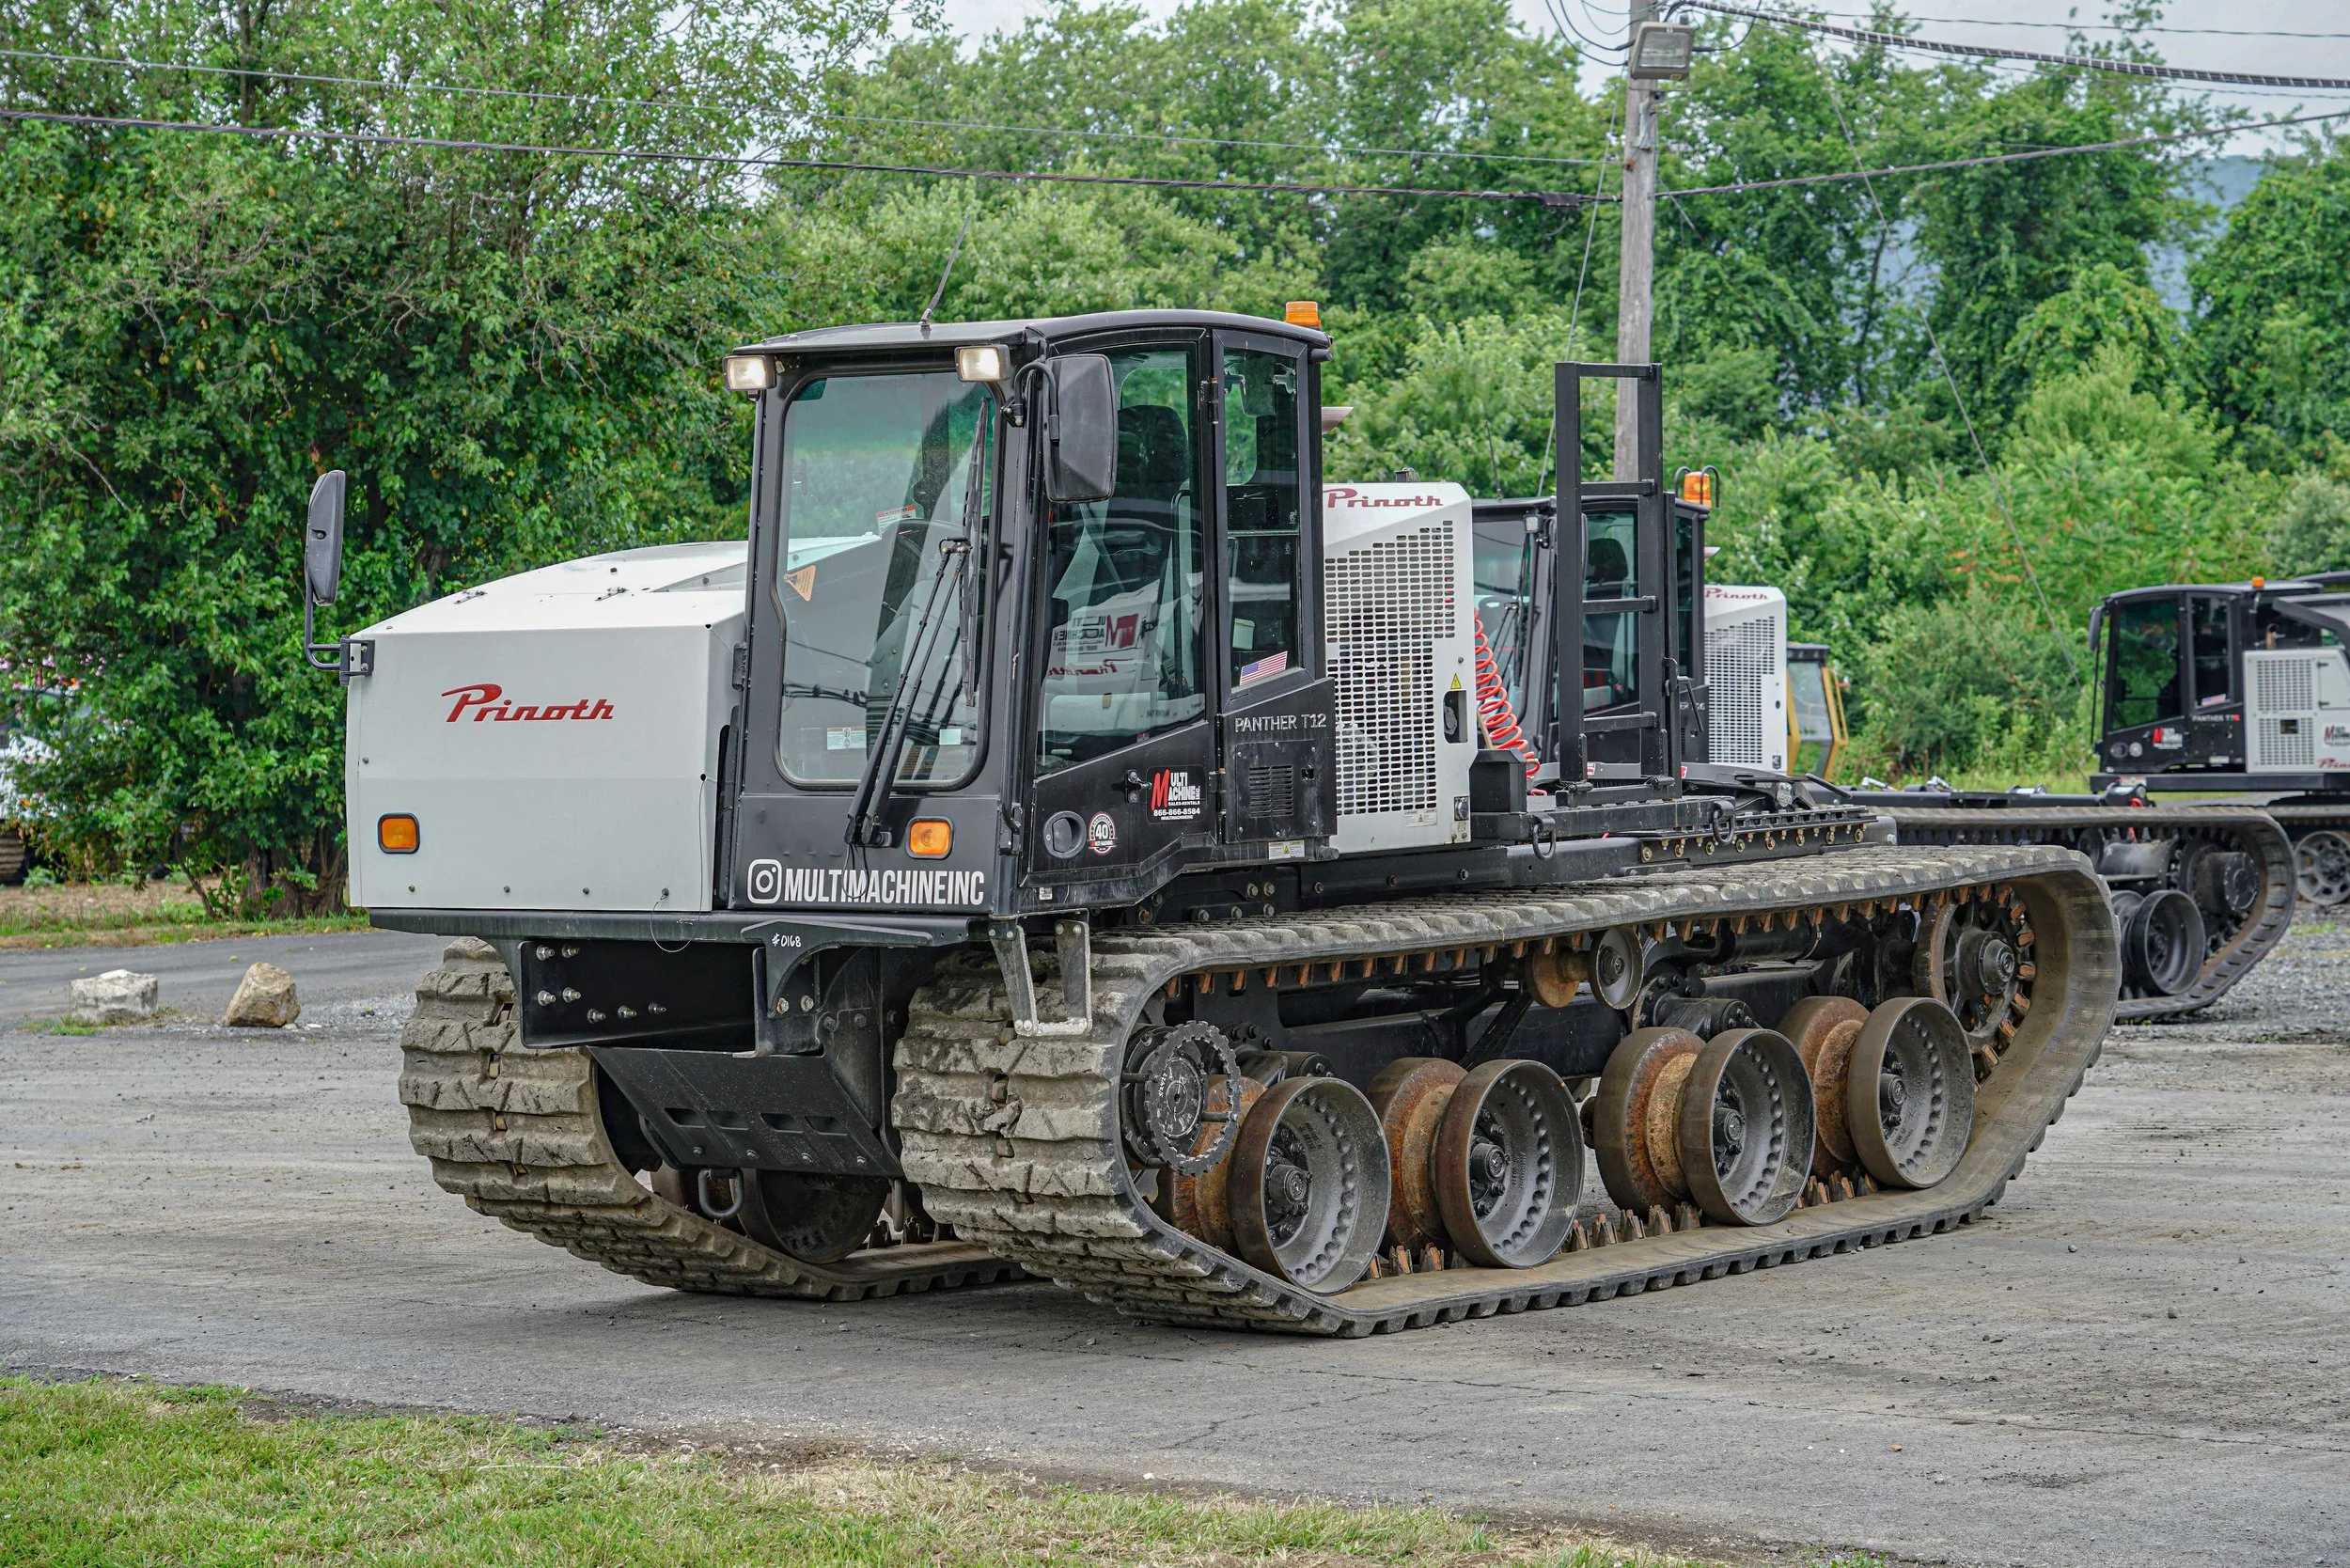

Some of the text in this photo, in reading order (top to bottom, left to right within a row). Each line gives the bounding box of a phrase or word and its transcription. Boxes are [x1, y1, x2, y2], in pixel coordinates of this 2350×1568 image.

[1323, 488, 1444, 509] Prinoth
[1704, 588, 1768, 600] Prinoth
[441, 683, 615, 723] Prinoth
[1234, 713, 1327, 732] PANTHER T12
[1153, 808, 1200, 817] 866-866-8584
[1095, 823, 1109, 839] 40
[784, 868, 985, 905] MULTIMACHINEINC
